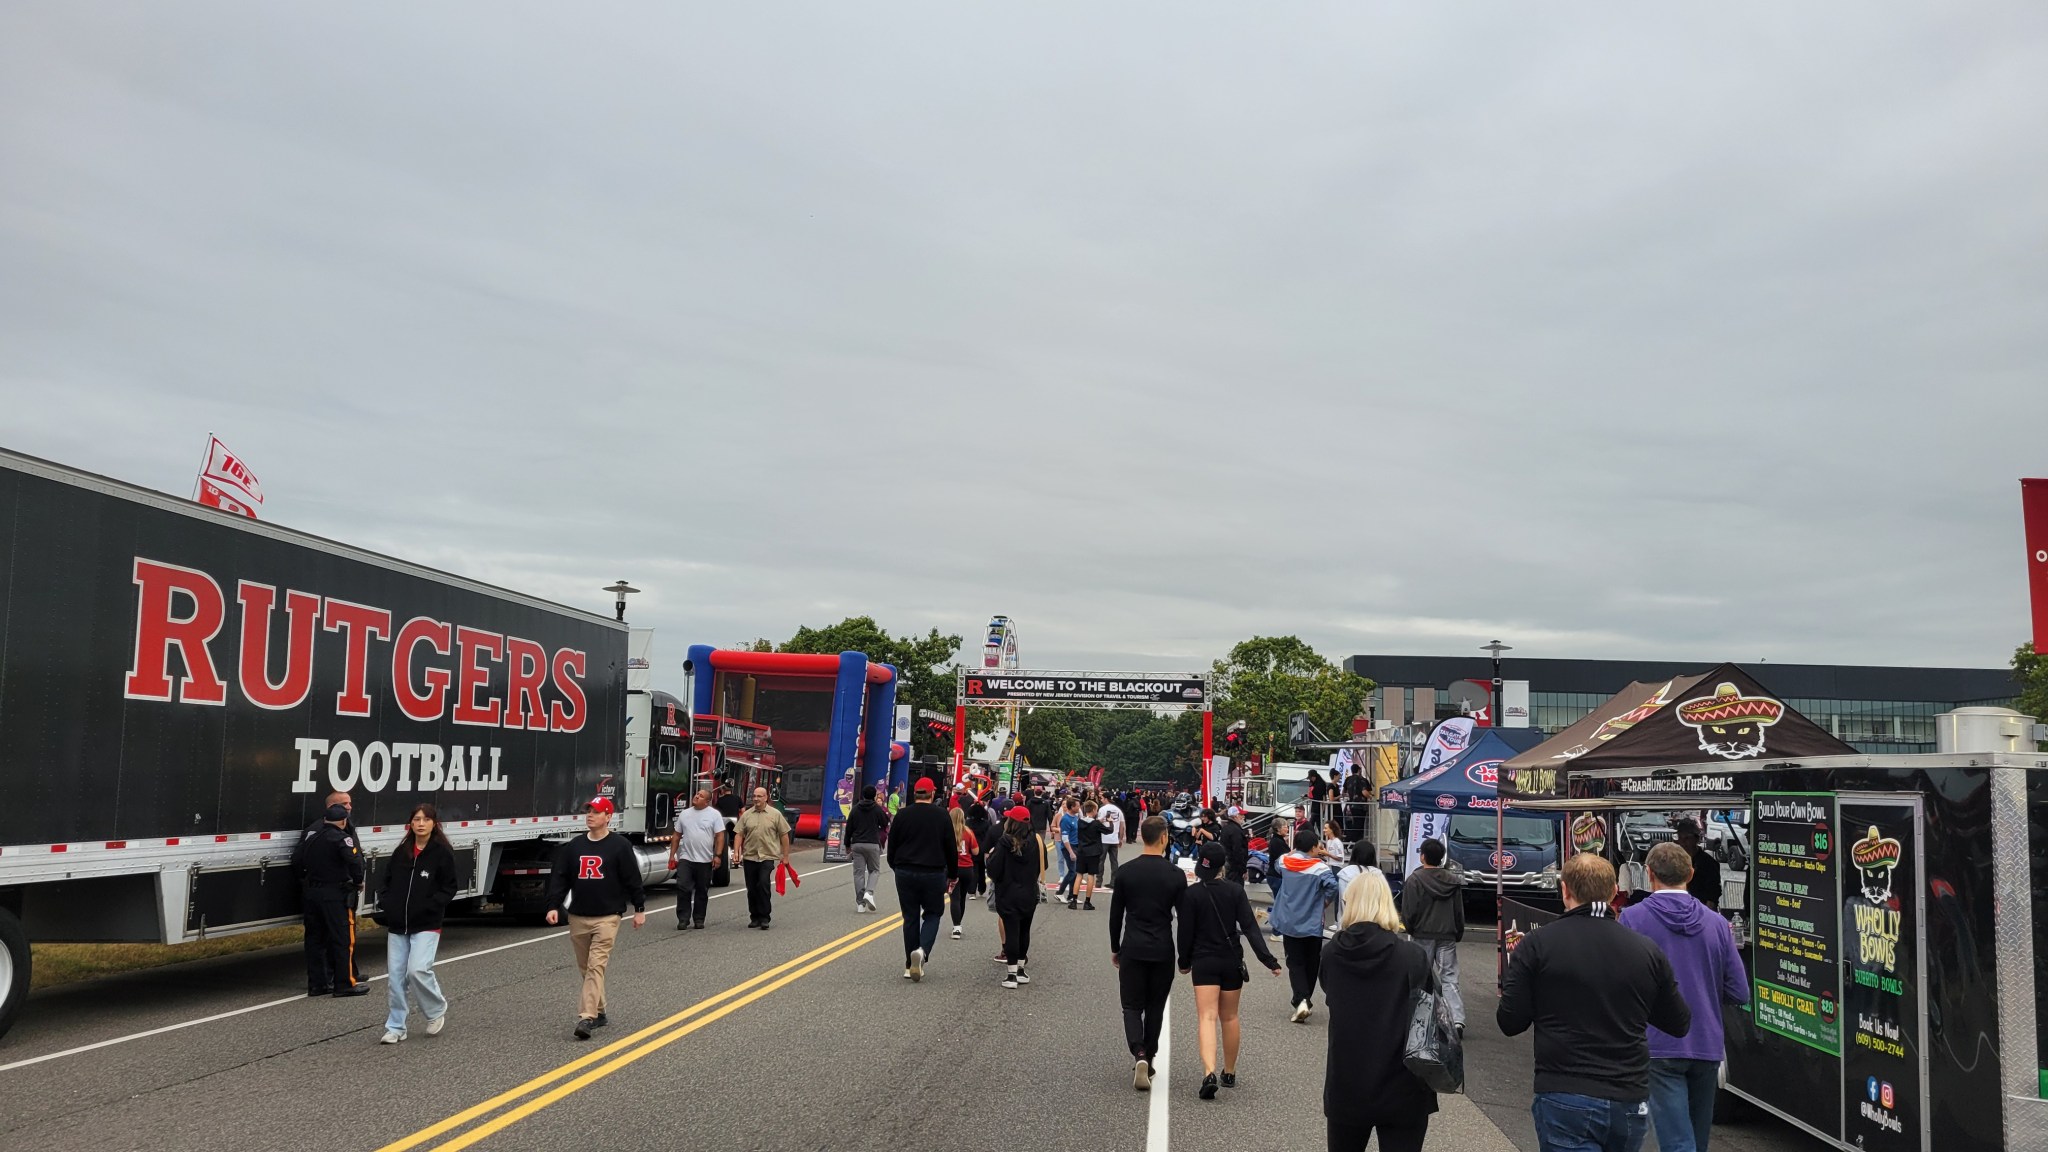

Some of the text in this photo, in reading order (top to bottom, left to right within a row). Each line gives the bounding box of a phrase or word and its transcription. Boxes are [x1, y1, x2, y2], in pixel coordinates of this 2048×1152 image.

[124, 556, 587, 733] RUTGERS
[967, 680, 983, 695] R
[986, 679, 1054, 690] WELCOME
[1057, 680, 1076, 691] TO
[1079, 681, 1106, 691] THE
[1109, 682, 1182, 693] BLACKOUT
[661, 726, 680, 737] FOOTBALL
[292, 737, 508, 793] FOOTBALL
[1758, 800, 1826, 822] BUILD YOUR OWN BOWL
[1814, 832, 1828, 850] $16
[578, 855, 604, 879] R
[1853, 904, 1900, 943] WHOLLY
[1860, 931, 1896, 973] BOWLS
[1855, 968, 1903, 996] BURRITO BOWLS
[1758, 985, 1770, 1000] THE
[1772, 990, 1794, 1008] WHOLLY
[1859, 1013, 1899, 1042] Book Us Now!
[1855, 1031, 1872, 1049] (609)
[1872, 1037, 1905, 1059] 500-2744
[1860, 1101, 1902, 1133] @WhollyBowls
